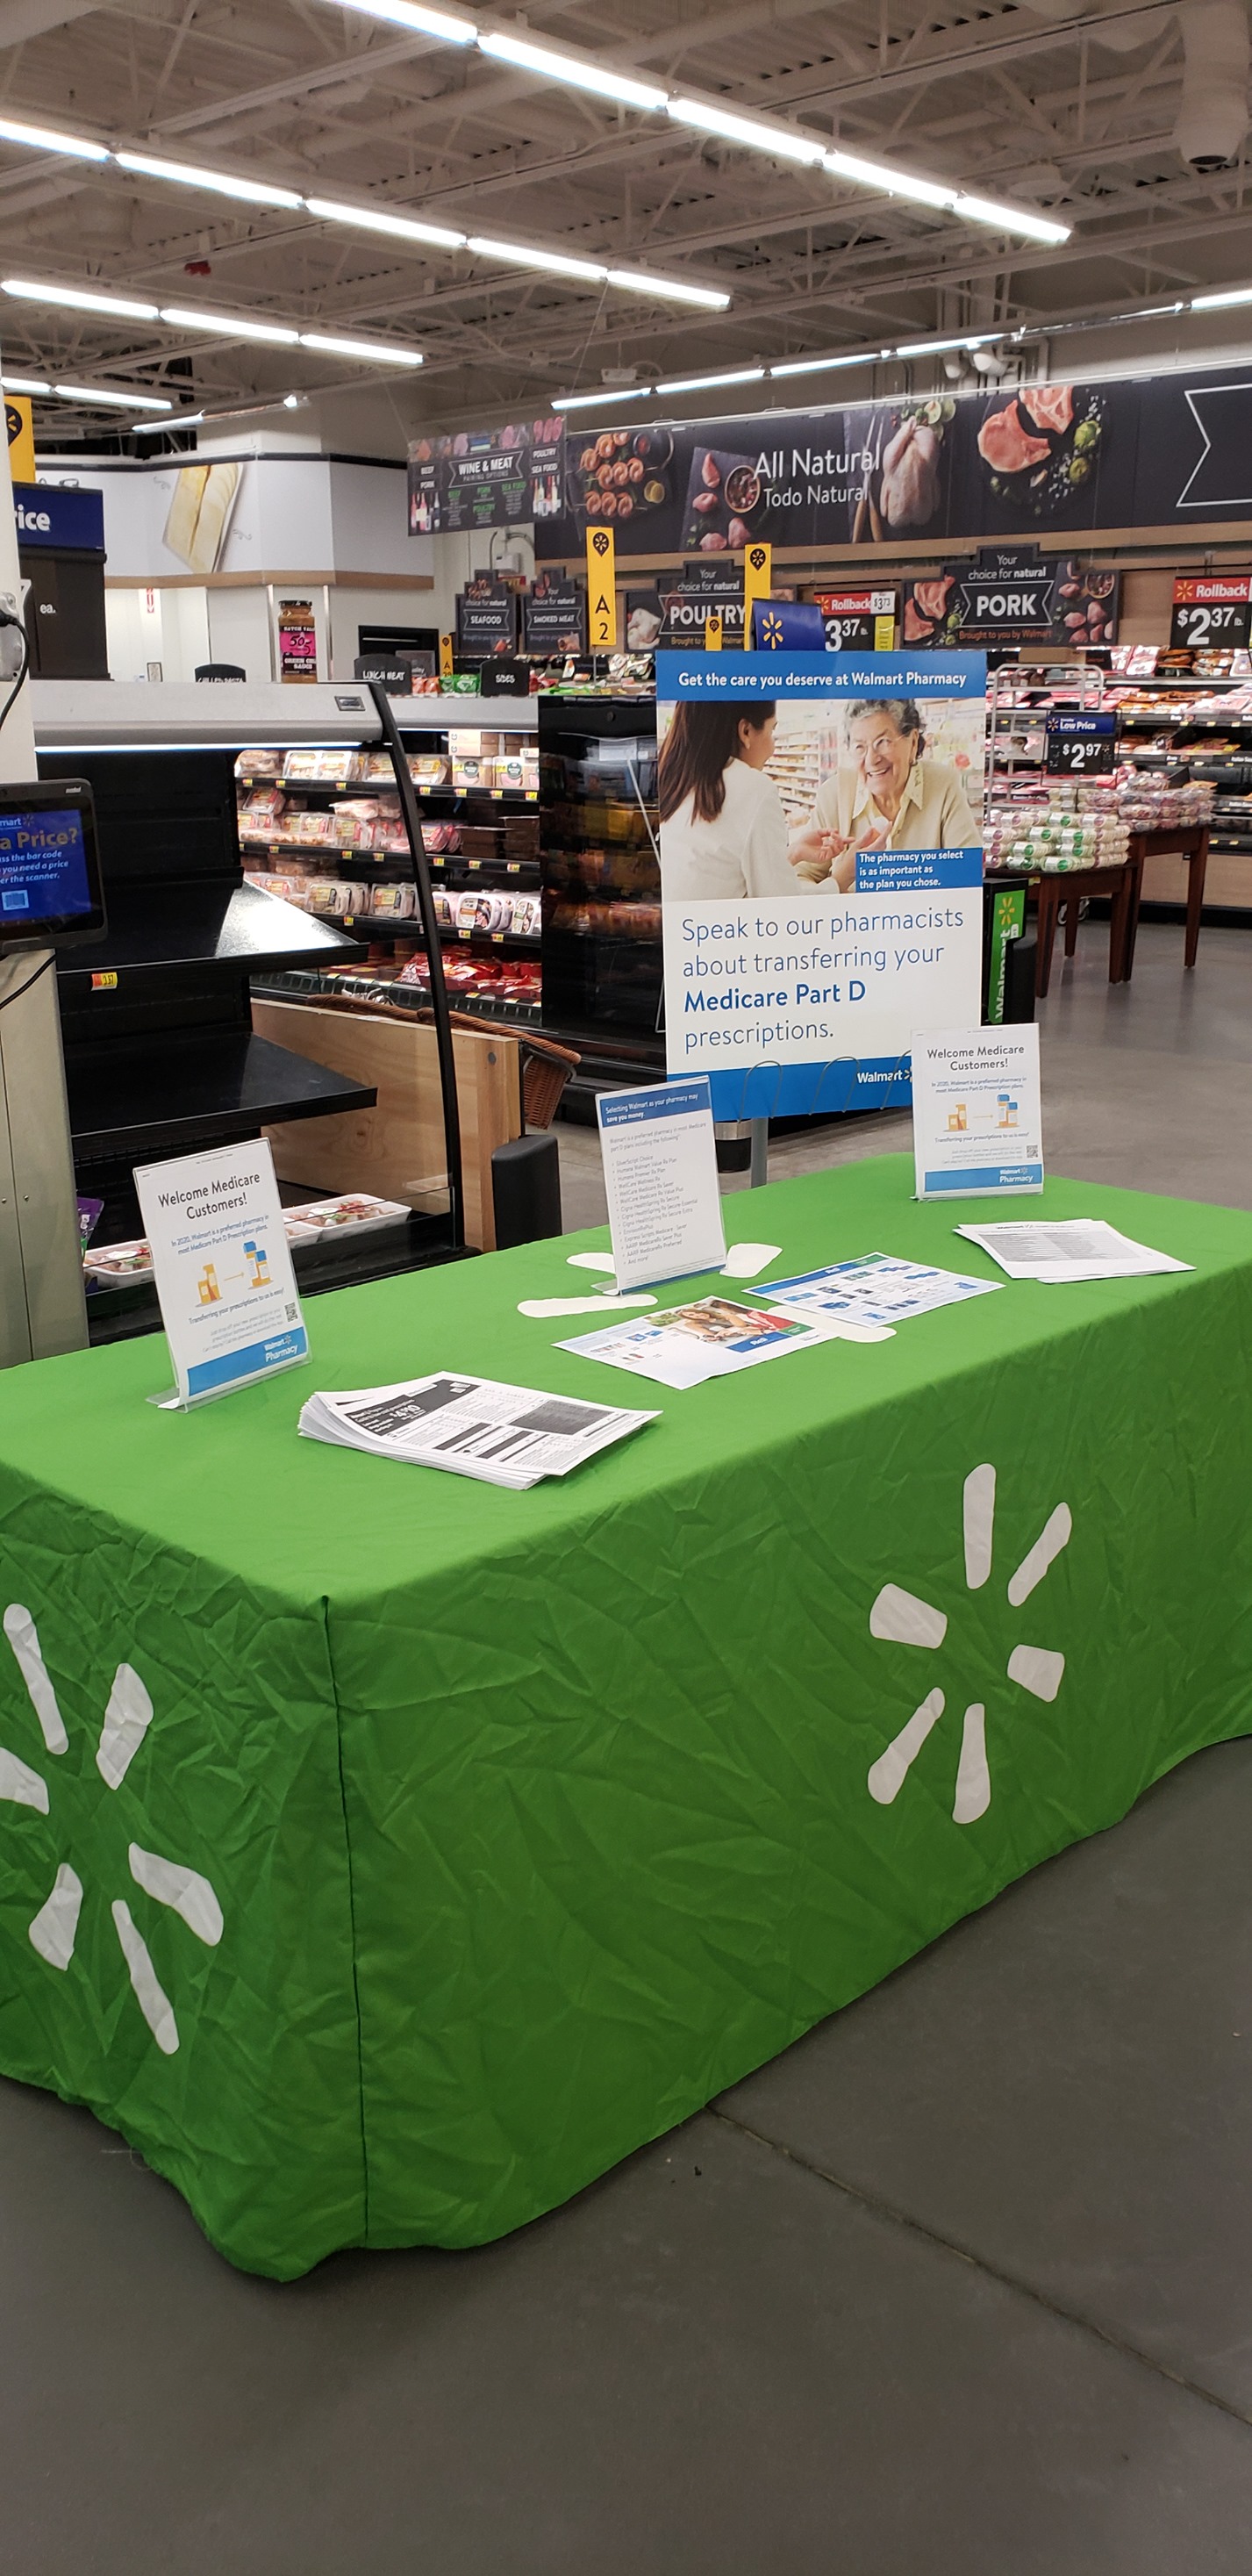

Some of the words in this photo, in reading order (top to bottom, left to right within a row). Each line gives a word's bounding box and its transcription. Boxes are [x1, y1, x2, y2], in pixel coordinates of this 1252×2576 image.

[459, 461, 481, 475] WINE
[483, 460, 489, 471] &
[490, 456, 513, 470] MEAT
[753, 450, 783, 480] All
[792, 448, 879, 477] Natural
[763, 487, 802, 507] Todo
[807, 484, 868, 505] Natural
[997, 554, 1018, 566] Your
[699, 570, 716, 578] Your
[968, 570, 997, 580] choice
[998, 569, 1013, 578] for
[1013, 567, 1047, 578] natural
[677, 582, 699, 592] choice
[702, 581, 712, 591] for
[713, 580, 740, 591] natural
[1196, 583, 1248, 598] Rollback
[39, 603, 56, 614] ea.
[595, 594, 610, 614] A
[977, 594, 1037, 617] PORK
[470, 615, 502, 624] SEAFOOD
[559, 614, 575, 623] MEAT
[670, 604, 745, 626] POULTRY
[599, 623, 608, 640] 2
[678, 672, 702, 686] Get
[705, 672, 727, 686] the
[730, 675, 757, 686] care
[760, 675, 782, 690] you
[785, 672, 833, 686] deserve
[835, 674, 848, 685] at
[851, 671, 904, 685] Walmart
[906, 671, 967, 688] Pharmacy
[1060, 721, 1076, 729] Low
[1077, 721, 1096, 730] Price
[17, 828, 77, 849] Price?
[11, 853, 25, 862] the
[42, 850, 62, 859] code
[860, 853, 876, 863] The
[877, 852, 919, 865] pharmacy
[921, 852, 937, 862] you
[938, 850, 963, 859] select
[3, 866, 18, 875] you
[19, 862, 40, 872] need
[48, 860, 69, 870] price
[860, 867, 867, 876] is
[879, 865, 922, 877] important
[25, 872, 61, 882] scanner.
[860, 880, 874, 889] the
[876, 879, 894, 891] plan
[896, 879, 912, 890] you
[913, 878, 941, 887] chose.
[683, 917, 748, 947] Speak
[755, 918, 778, 937] to
[786, 919, 824, 936] our
[831, 908, 964, 940] pharmacists
[683, 954, 748, 977] about
[754, 946, 886, 972] transferring
[894, 945, 945, 971] your
[684, 987, 788, 1013] Medicare
[796, 982, 841, 1005] Part
[849, 980, 866, 1001] D
[685, 1020, 834, 1055] prescriptions.
[927, 1048, 975, 1059] Welcome
[977, 1045, 1025, 1057] Medicare
[950, 1058, 1008, 1071] Customers!
[857, 1069, 903, 1084] Walmart
[999, 1174, 1034, 1183] Pharmacy
[158, 1187, 209, 1208] Welcome
[211, 1173, 261, 1195] Medicare
[186, 1192, 247, 1219] Customers!
[265, 1345, 297, 1363] Pharmacy
